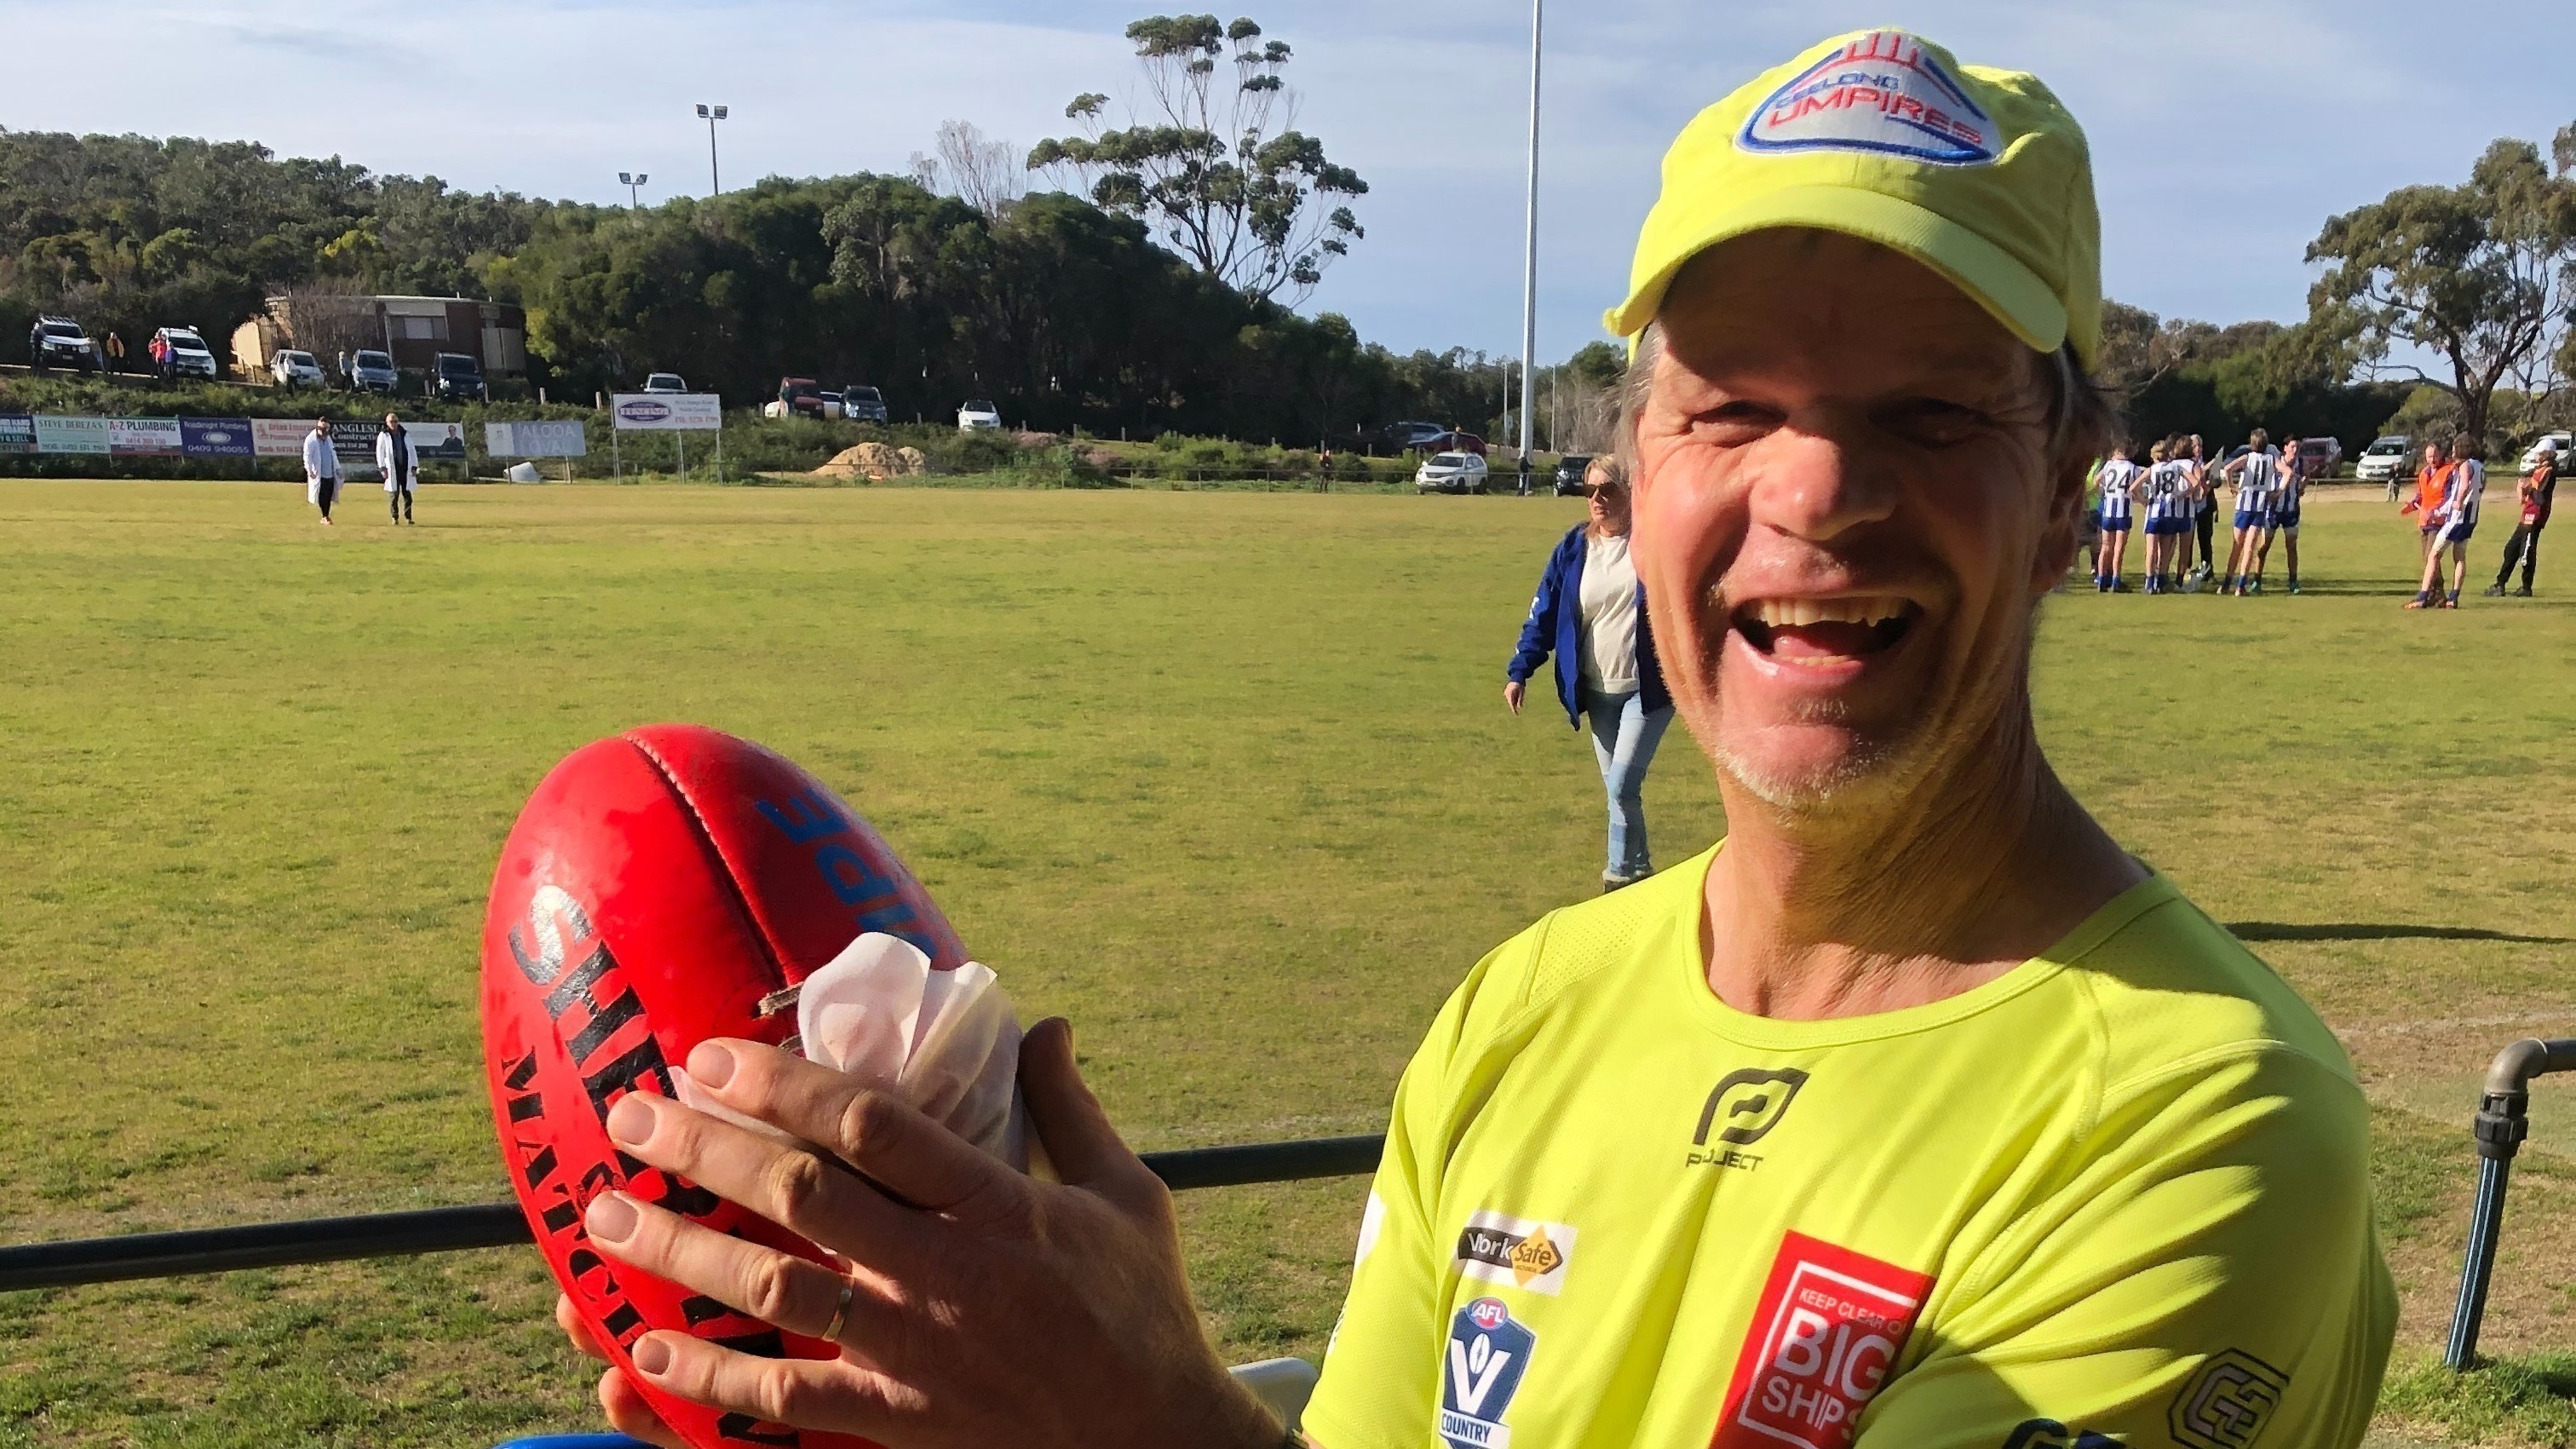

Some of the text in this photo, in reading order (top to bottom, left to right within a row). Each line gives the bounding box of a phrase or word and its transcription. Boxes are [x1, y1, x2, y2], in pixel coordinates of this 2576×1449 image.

[1768, 84, 1983, 144] UMPIRES
[109, 421, 176, 432] A-Z PLUMBING
[522, 424, 576, 438] ALCOA
[2106, 468, 2131, 493] 24
[2155, 470, 2175, 494] 18
[2253, 460, 2267, 486] 11
[1471, 1302, 1504, 1324] AFL
[1797, 1287, 1837, 1310] KEEP
[1837, 1301, 1887, 1331] CLEAR
[1774, 1306, 1896, 1402] BIG
[1441, 1413, 1492, 1444] COUNTRY
